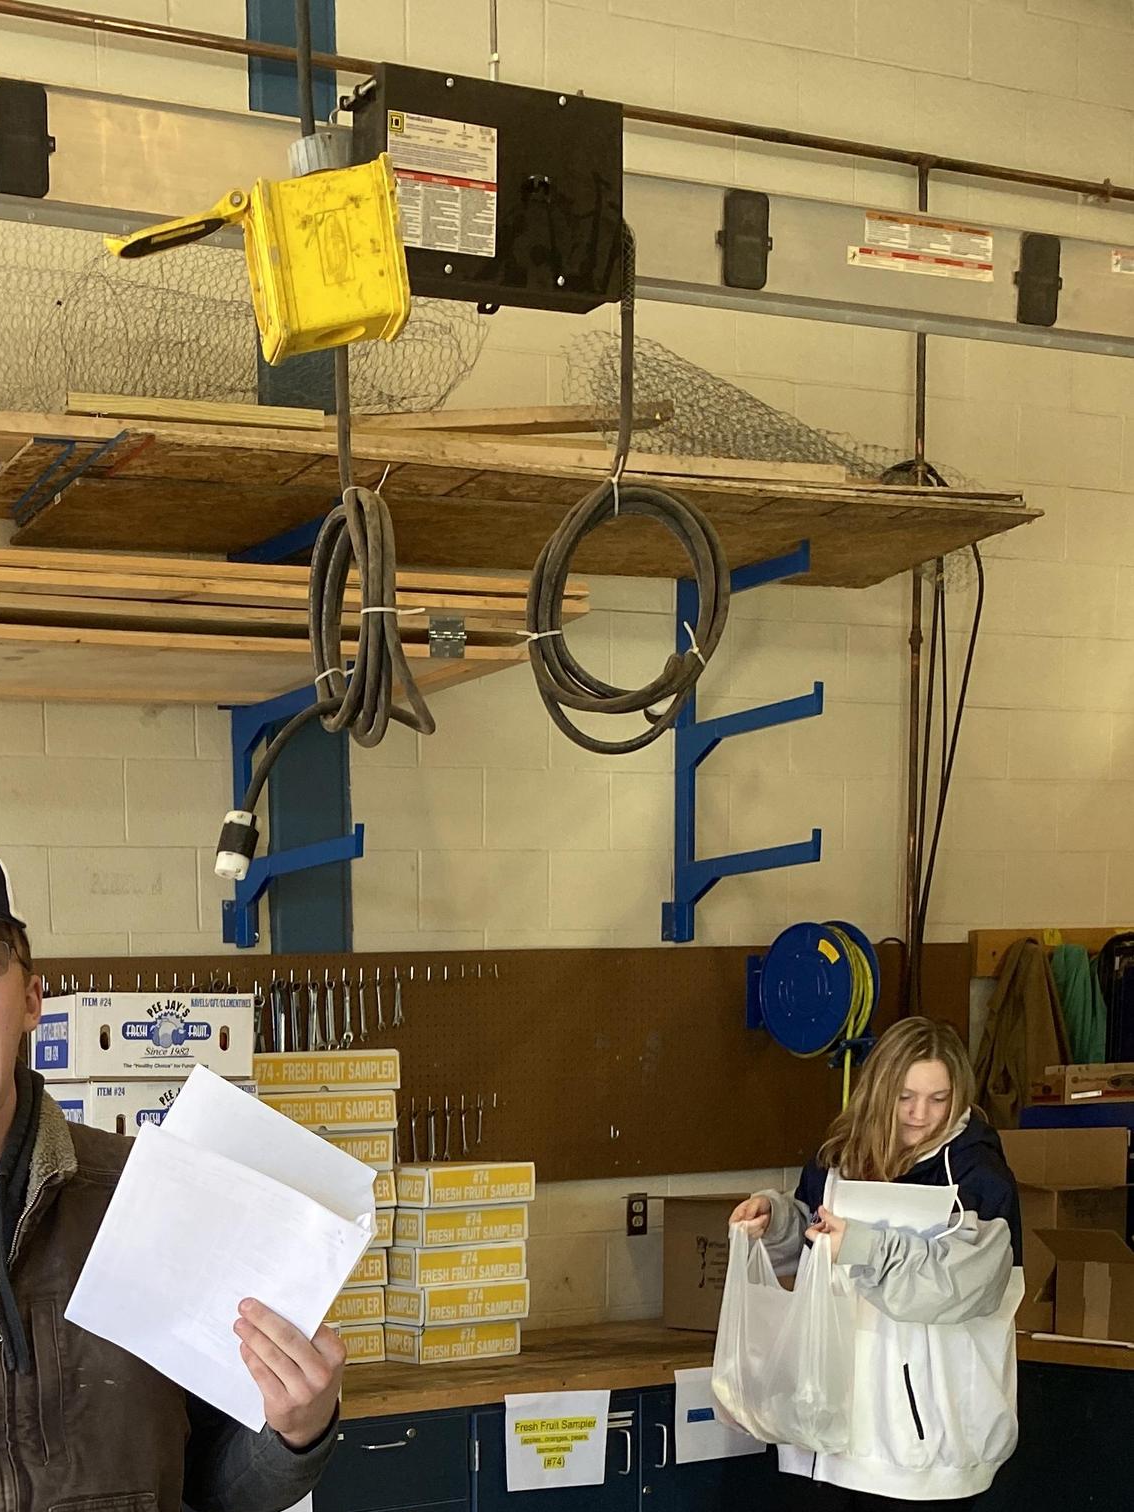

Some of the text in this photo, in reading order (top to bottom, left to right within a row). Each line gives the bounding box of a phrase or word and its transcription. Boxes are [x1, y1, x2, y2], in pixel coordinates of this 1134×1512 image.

[82, 998, 98, 1006] ITEM
[147, 999, 190, 1017] PEE JAY'S
[145, 1047, 168, 1056] Since
[282, 1063, 313, 1080] FRESH
[317, 1062, 344, 1080] FRUIT
[348, 1060, 395, 1080] SAMPLER
[315, 1102, 342, 1120] FRUIT
[345, 1100, 392, 1119] SAMPLER
[434, 1183, 531, 1200] FRESH FRUIT SAMPLER
[427, 1224, 523, 1242] FRESH FRUIT SAMPLER
[335, 1298, 380, 1316] SAMPLER
[514, 1420, 596, 1432] Fresh Fruit Sampler
